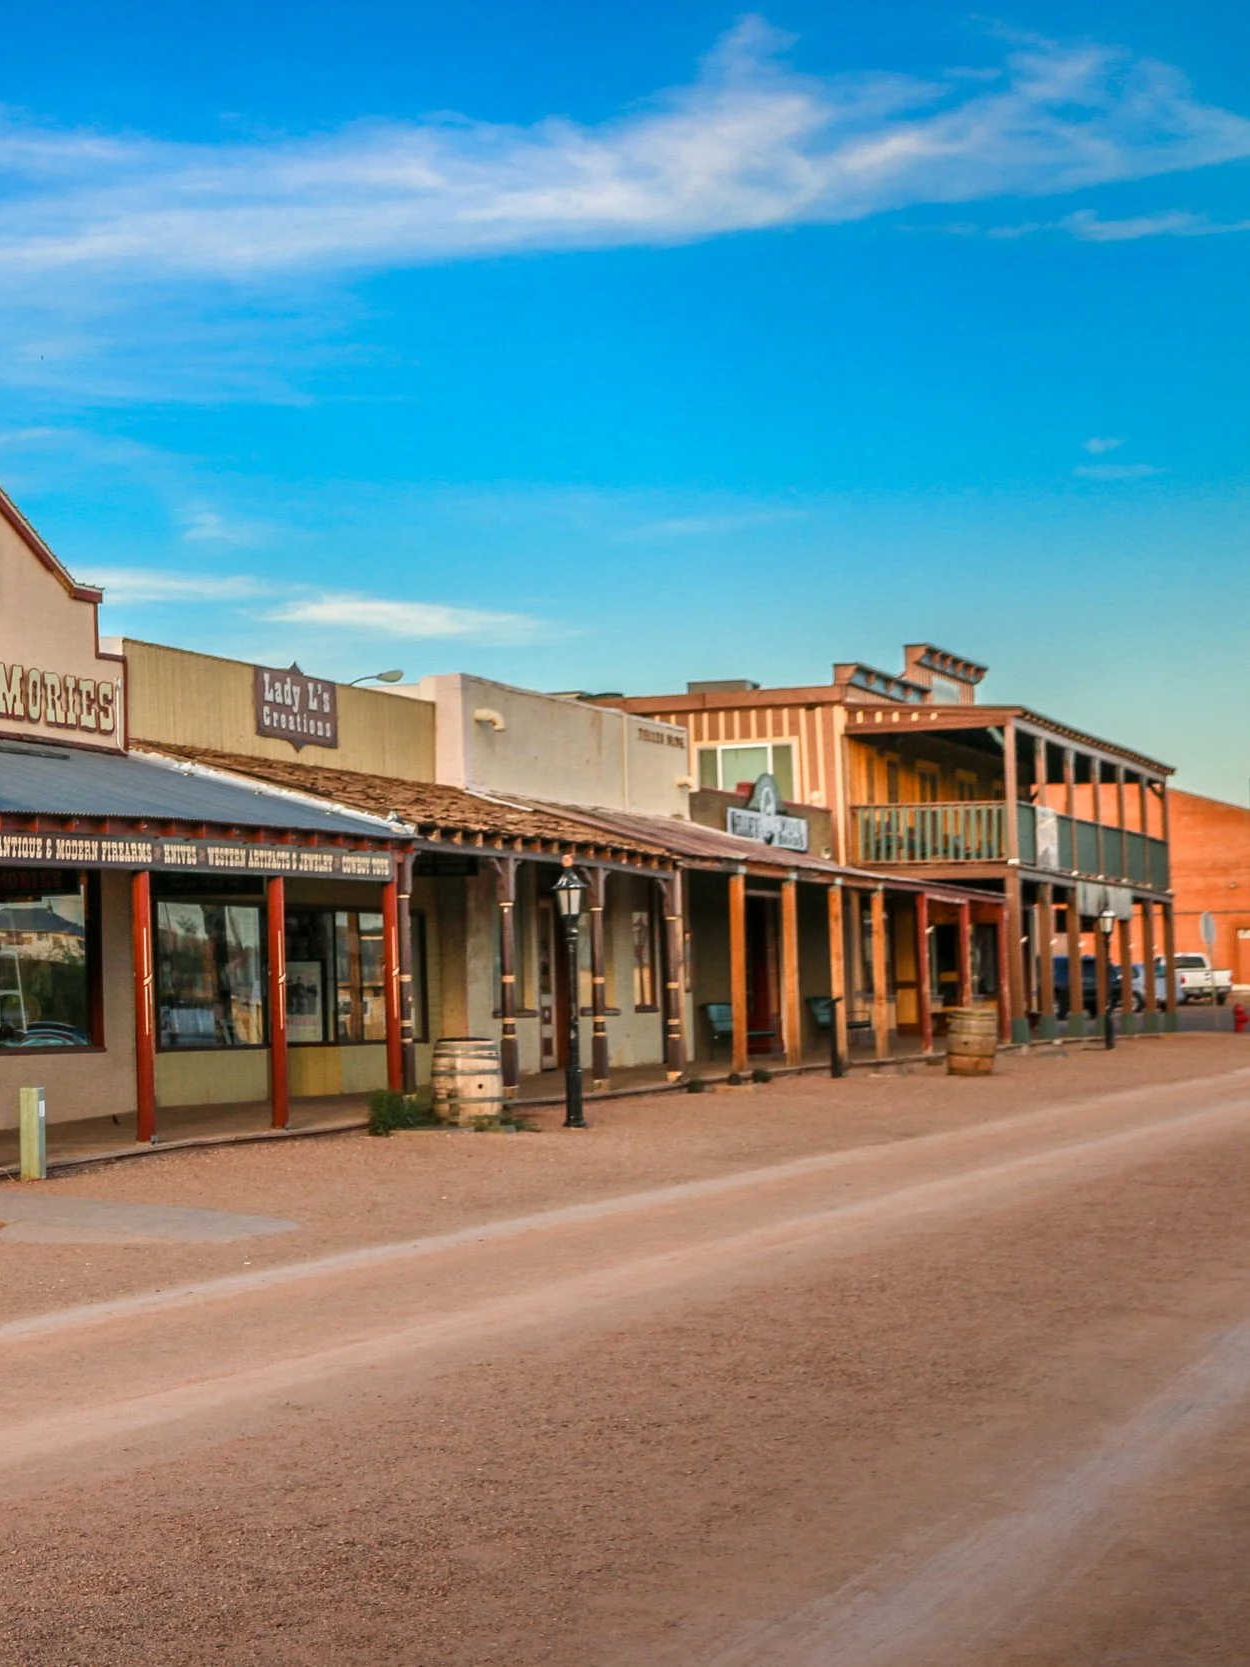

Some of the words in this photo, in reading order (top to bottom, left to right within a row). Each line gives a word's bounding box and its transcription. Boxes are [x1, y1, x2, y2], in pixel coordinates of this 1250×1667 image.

[263, 672, 301, 713] Lady
[307, 682, 330, 713] L's
[263, 705, 331, 738] Creations
[46, 838, 53, 860] &
[56, 838, 99, 862] MODERN
[101, 841, 153, 864] FIREARMS
[163, 844, 197, 866] KNIVES
[207, 846, 246, 868] WESTERN
[248, 849, 291, 870] ARTIFACTS
[299, 853, 333, 873] JEWELRY
